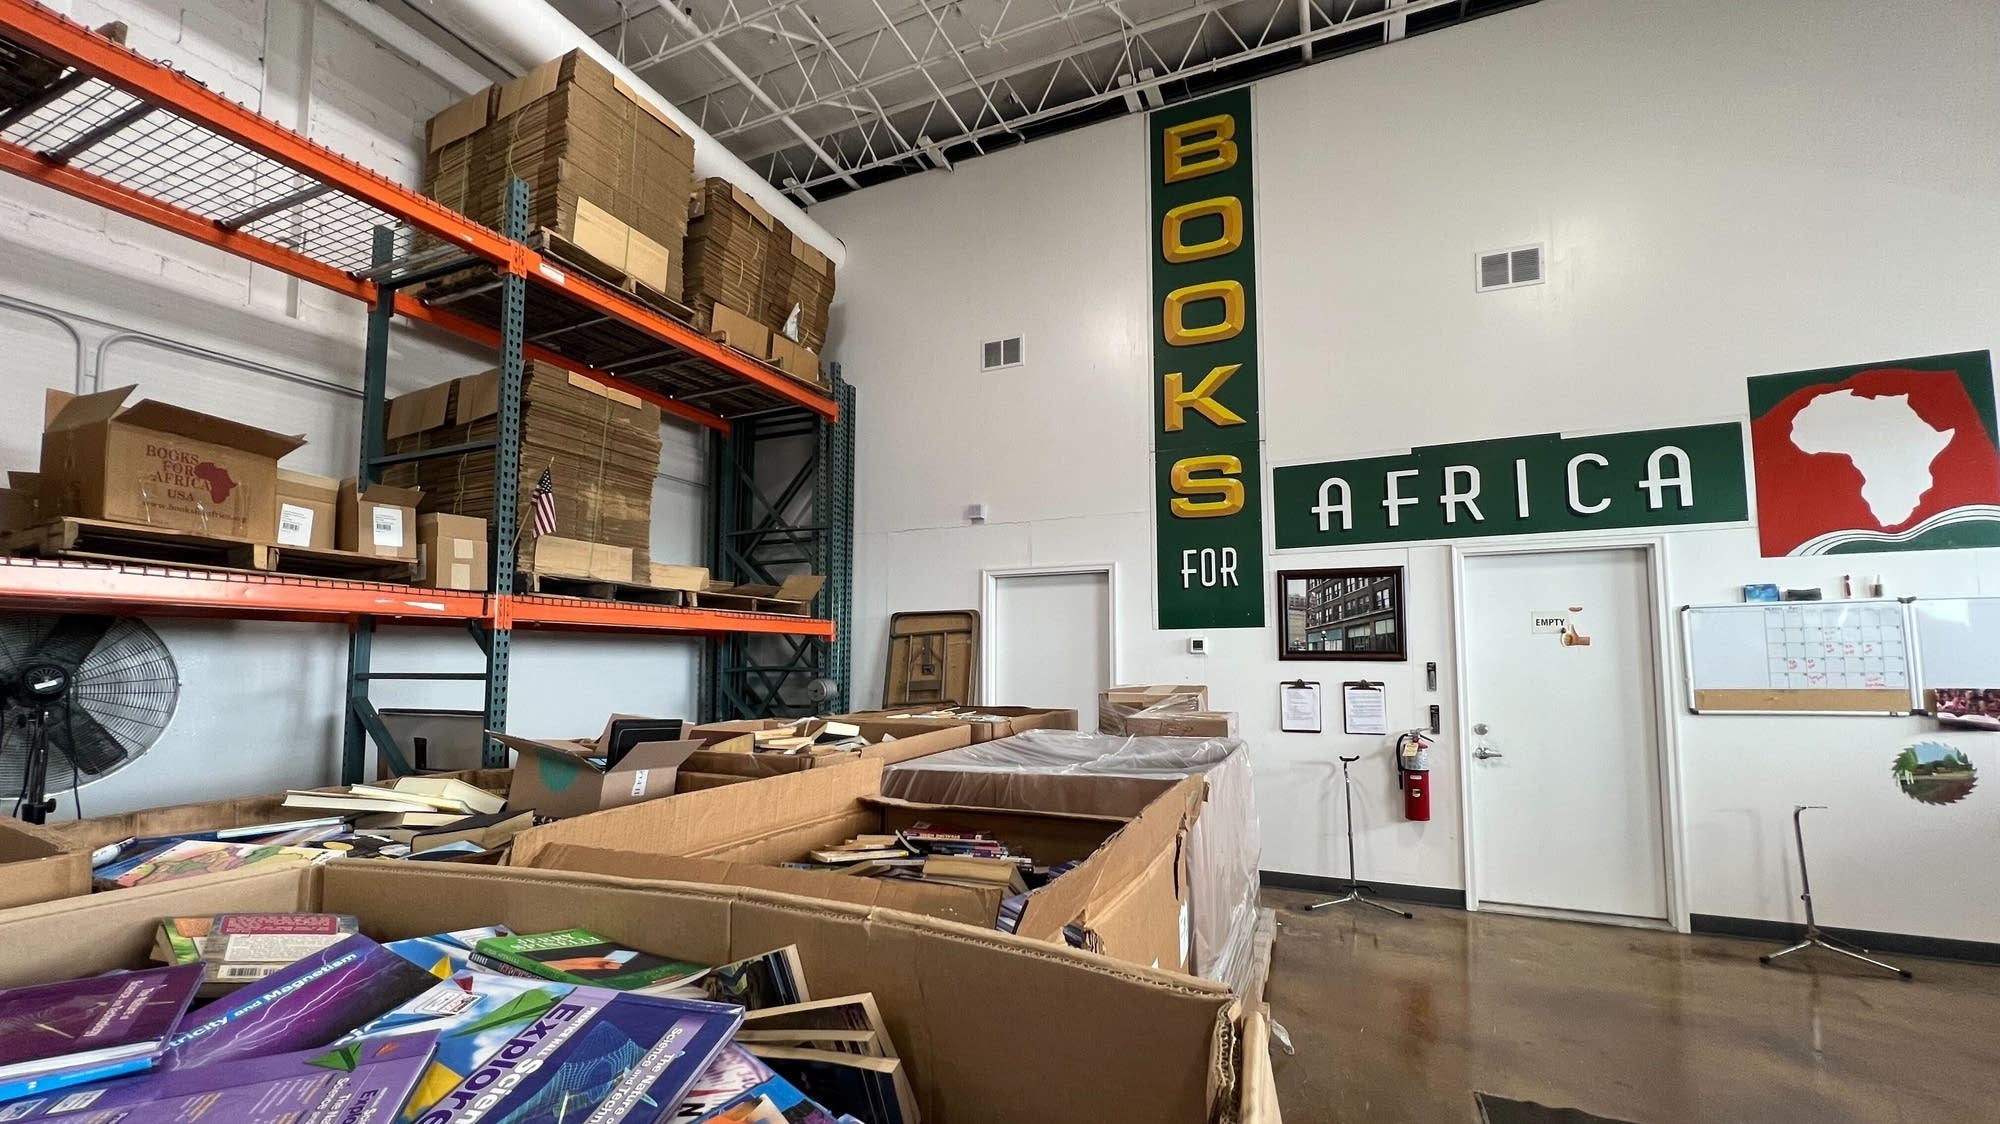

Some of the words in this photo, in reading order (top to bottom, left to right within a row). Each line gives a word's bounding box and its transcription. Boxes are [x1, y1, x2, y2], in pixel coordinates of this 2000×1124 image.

[1162, 113, 1247, 518] BOOKS
[146, 445, 200, 465] BOOKS
[163, 460, 194, 477] FOR
[152, 471, 211, 492] AFRICA
[1311, 445, 1694, 531] AFRICA
[167, 489, 194, 501] USA
[1181, 547, 1239, 588] FOR
[1535, 618, 1565, 627] EMPTY
[165, 1014, 228, 1049] tricity
[234, 1000, 263, 1017] and
[263, 952, 357, 1001] Magnetism
[559, 1006, 599, 1039] PRENTICE
[537, 1038, 562, 1057] HALL
[641, 1027, 683, 1067] Science
[652, 1053, 677, 1073] The
[624, 1069, 642, 1085] and
[614, 1074, 656, 1115] Nature
